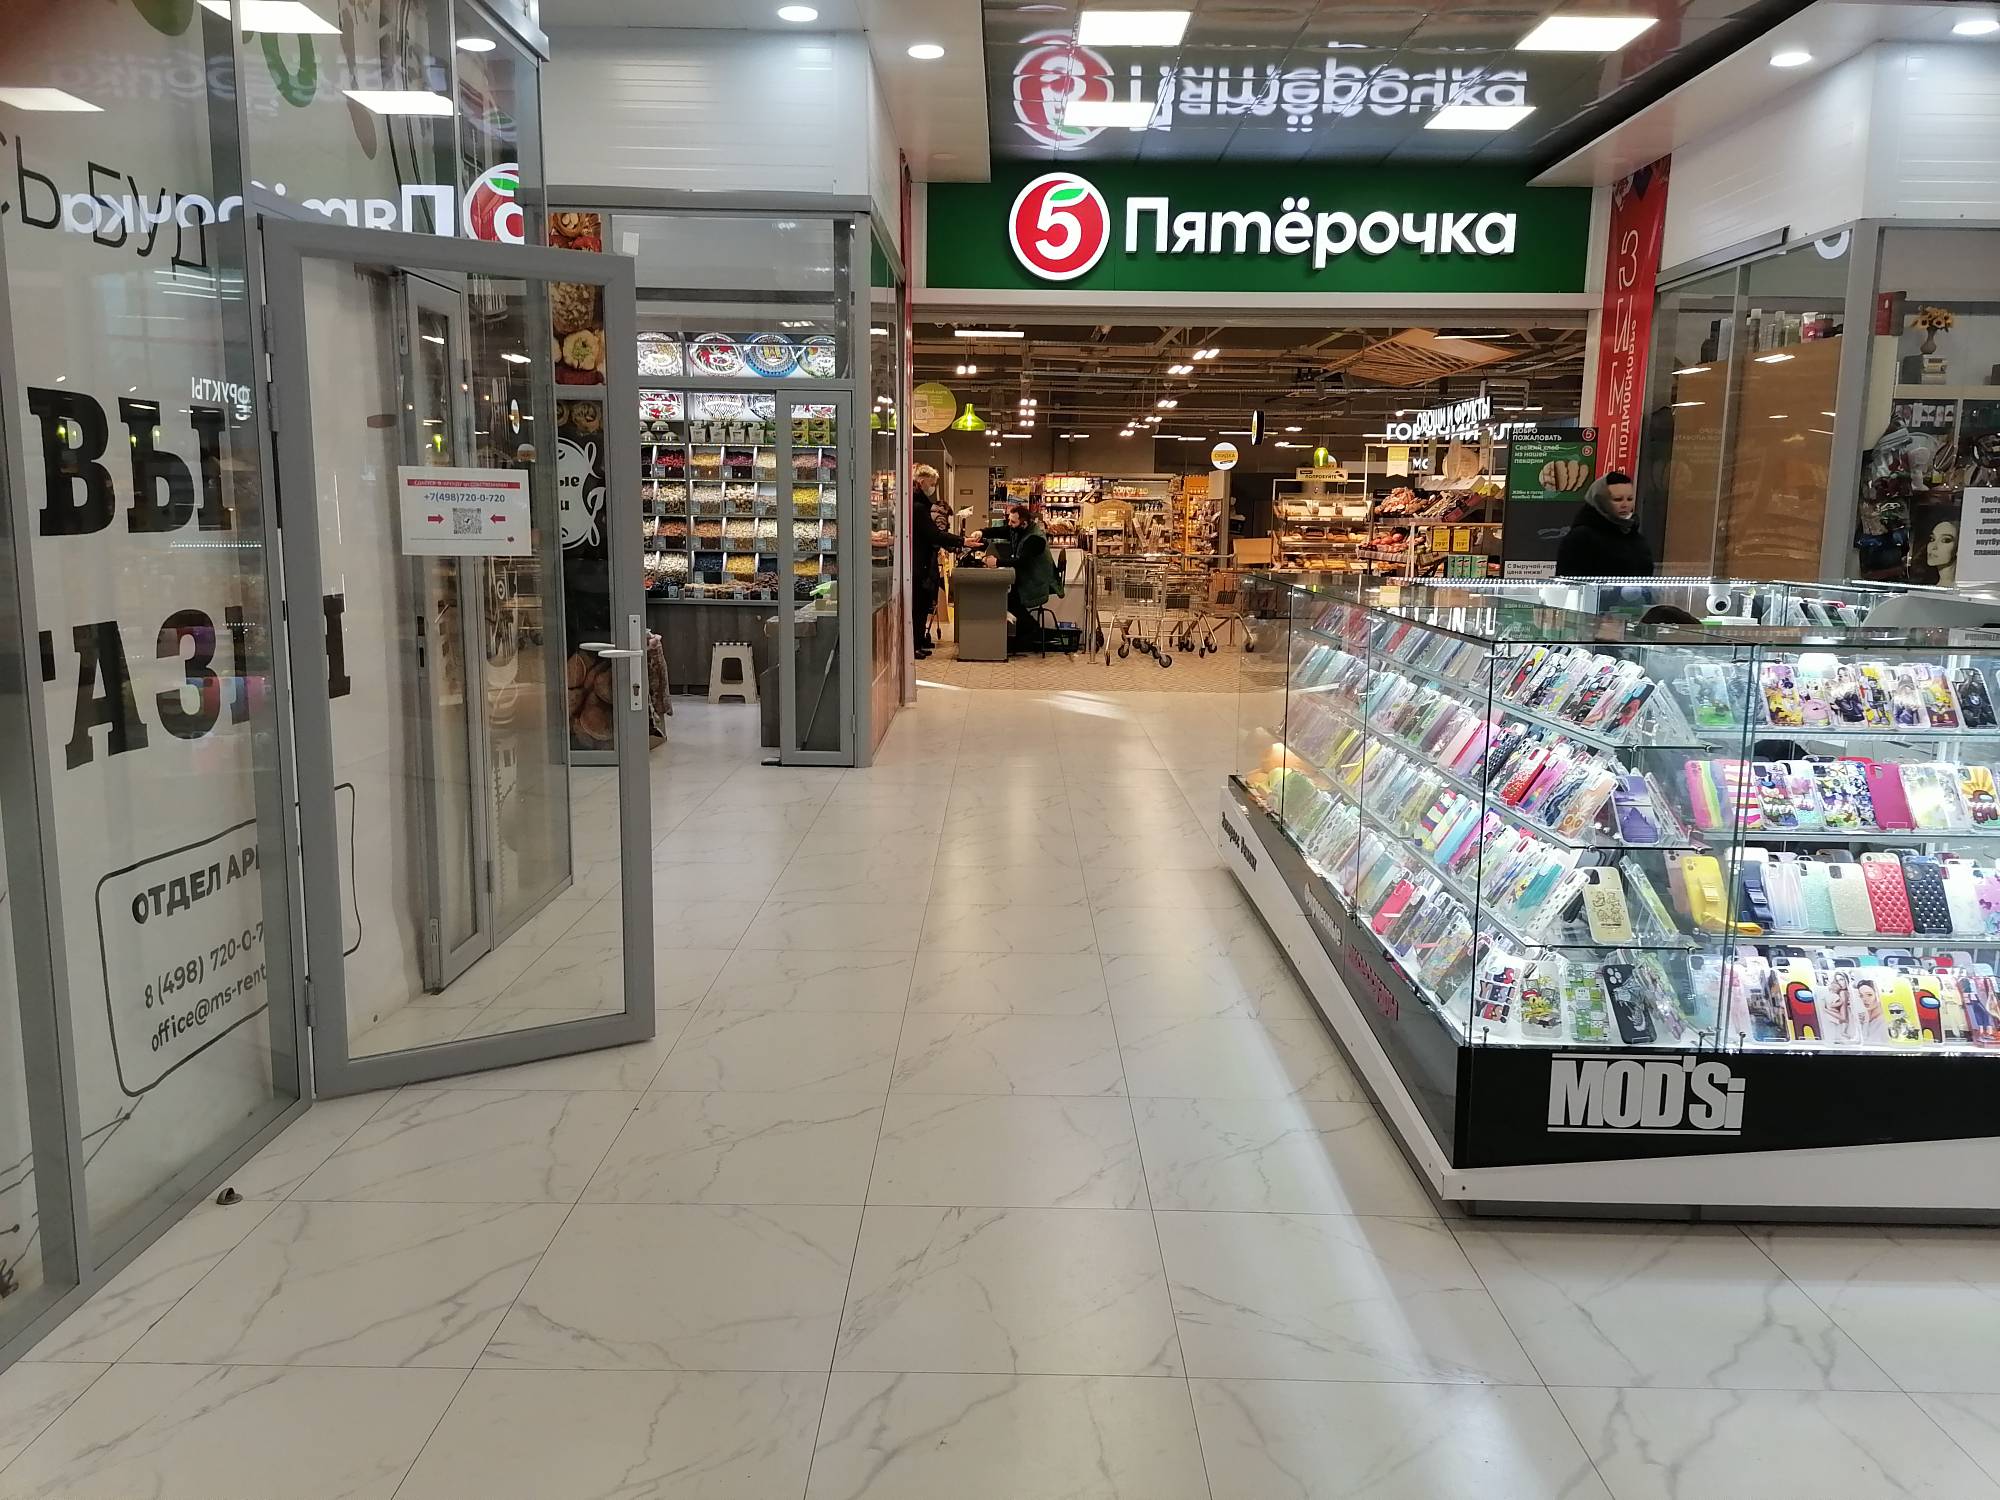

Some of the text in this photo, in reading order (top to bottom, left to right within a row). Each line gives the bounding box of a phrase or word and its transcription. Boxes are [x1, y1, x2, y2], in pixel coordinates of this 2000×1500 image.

[1124, 197, 1519, 270] Пятёрочка
[1417, 407, 1446, 432] ОВОЩИ
[1454, 396, 1490, 425] ФРУКТЫ
[1512, 427, 1538, 437] ДОБРО
[424, 492, 505, 503] +7(498)720-0-720
[131, 862, 221, 924] ОТДЕЛ
[144, 983, 154, 1009] 8
[158, 955, 204, 1006] (498)
